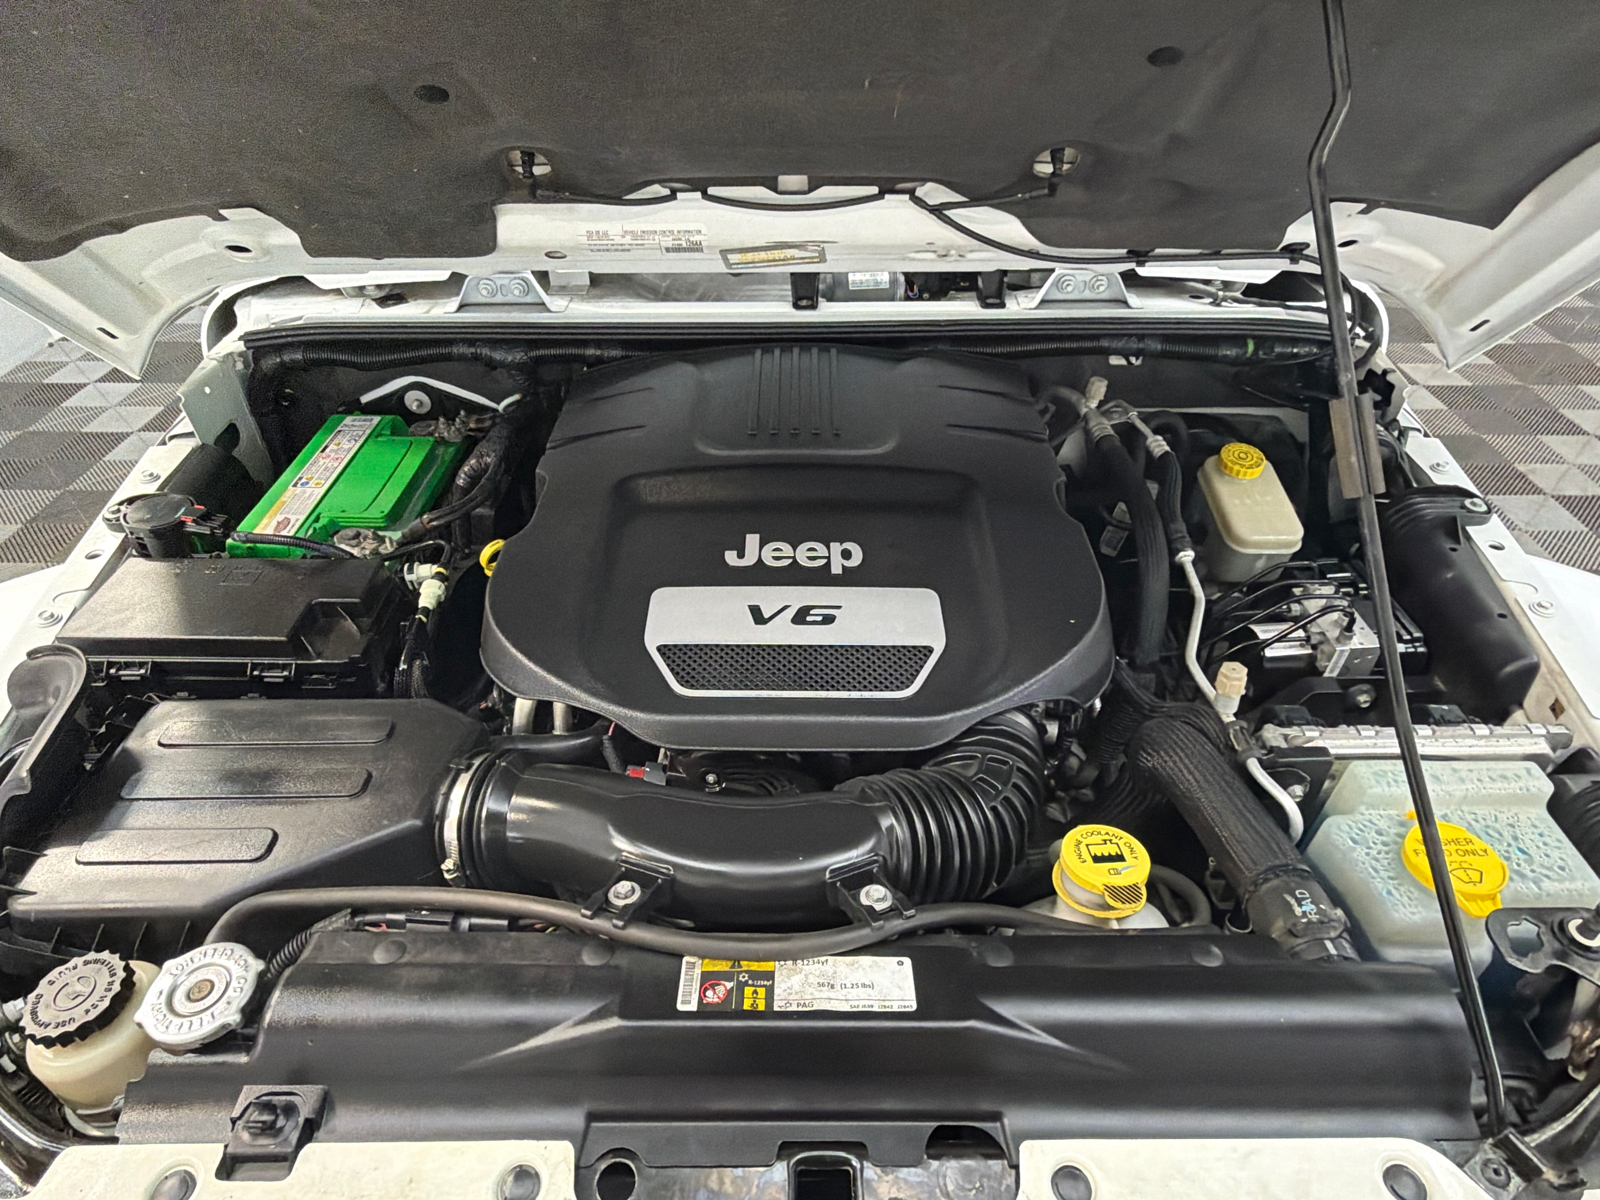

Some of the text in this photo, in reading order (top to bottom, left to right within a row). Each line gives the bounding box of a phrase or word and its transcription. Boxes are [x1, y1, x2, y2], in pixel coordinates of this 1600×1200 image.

[724, 533, 863, 575] Jeep
[747, 604, 843, 626] V6
[1074, 830, 1139, 864] ENGINE COOLANT ONLY
[1415, 837, 1475, 847] SHER
[1455, 848, 1489, 857] ONLY
[1295, 889, 1319, 919] RAD
[197, 947, 234, 960] OPEN
[791, 958, 829, 967] R-1234yf
[47, 963, 78, 986] FLUID
[816, 981, 875, 989] 567g (1.25 lbs)
[83, 979, 116, 1016] POWER
[796, 1001, 814, 1009] PAG
[52, 1016, 76, 1029] USE
